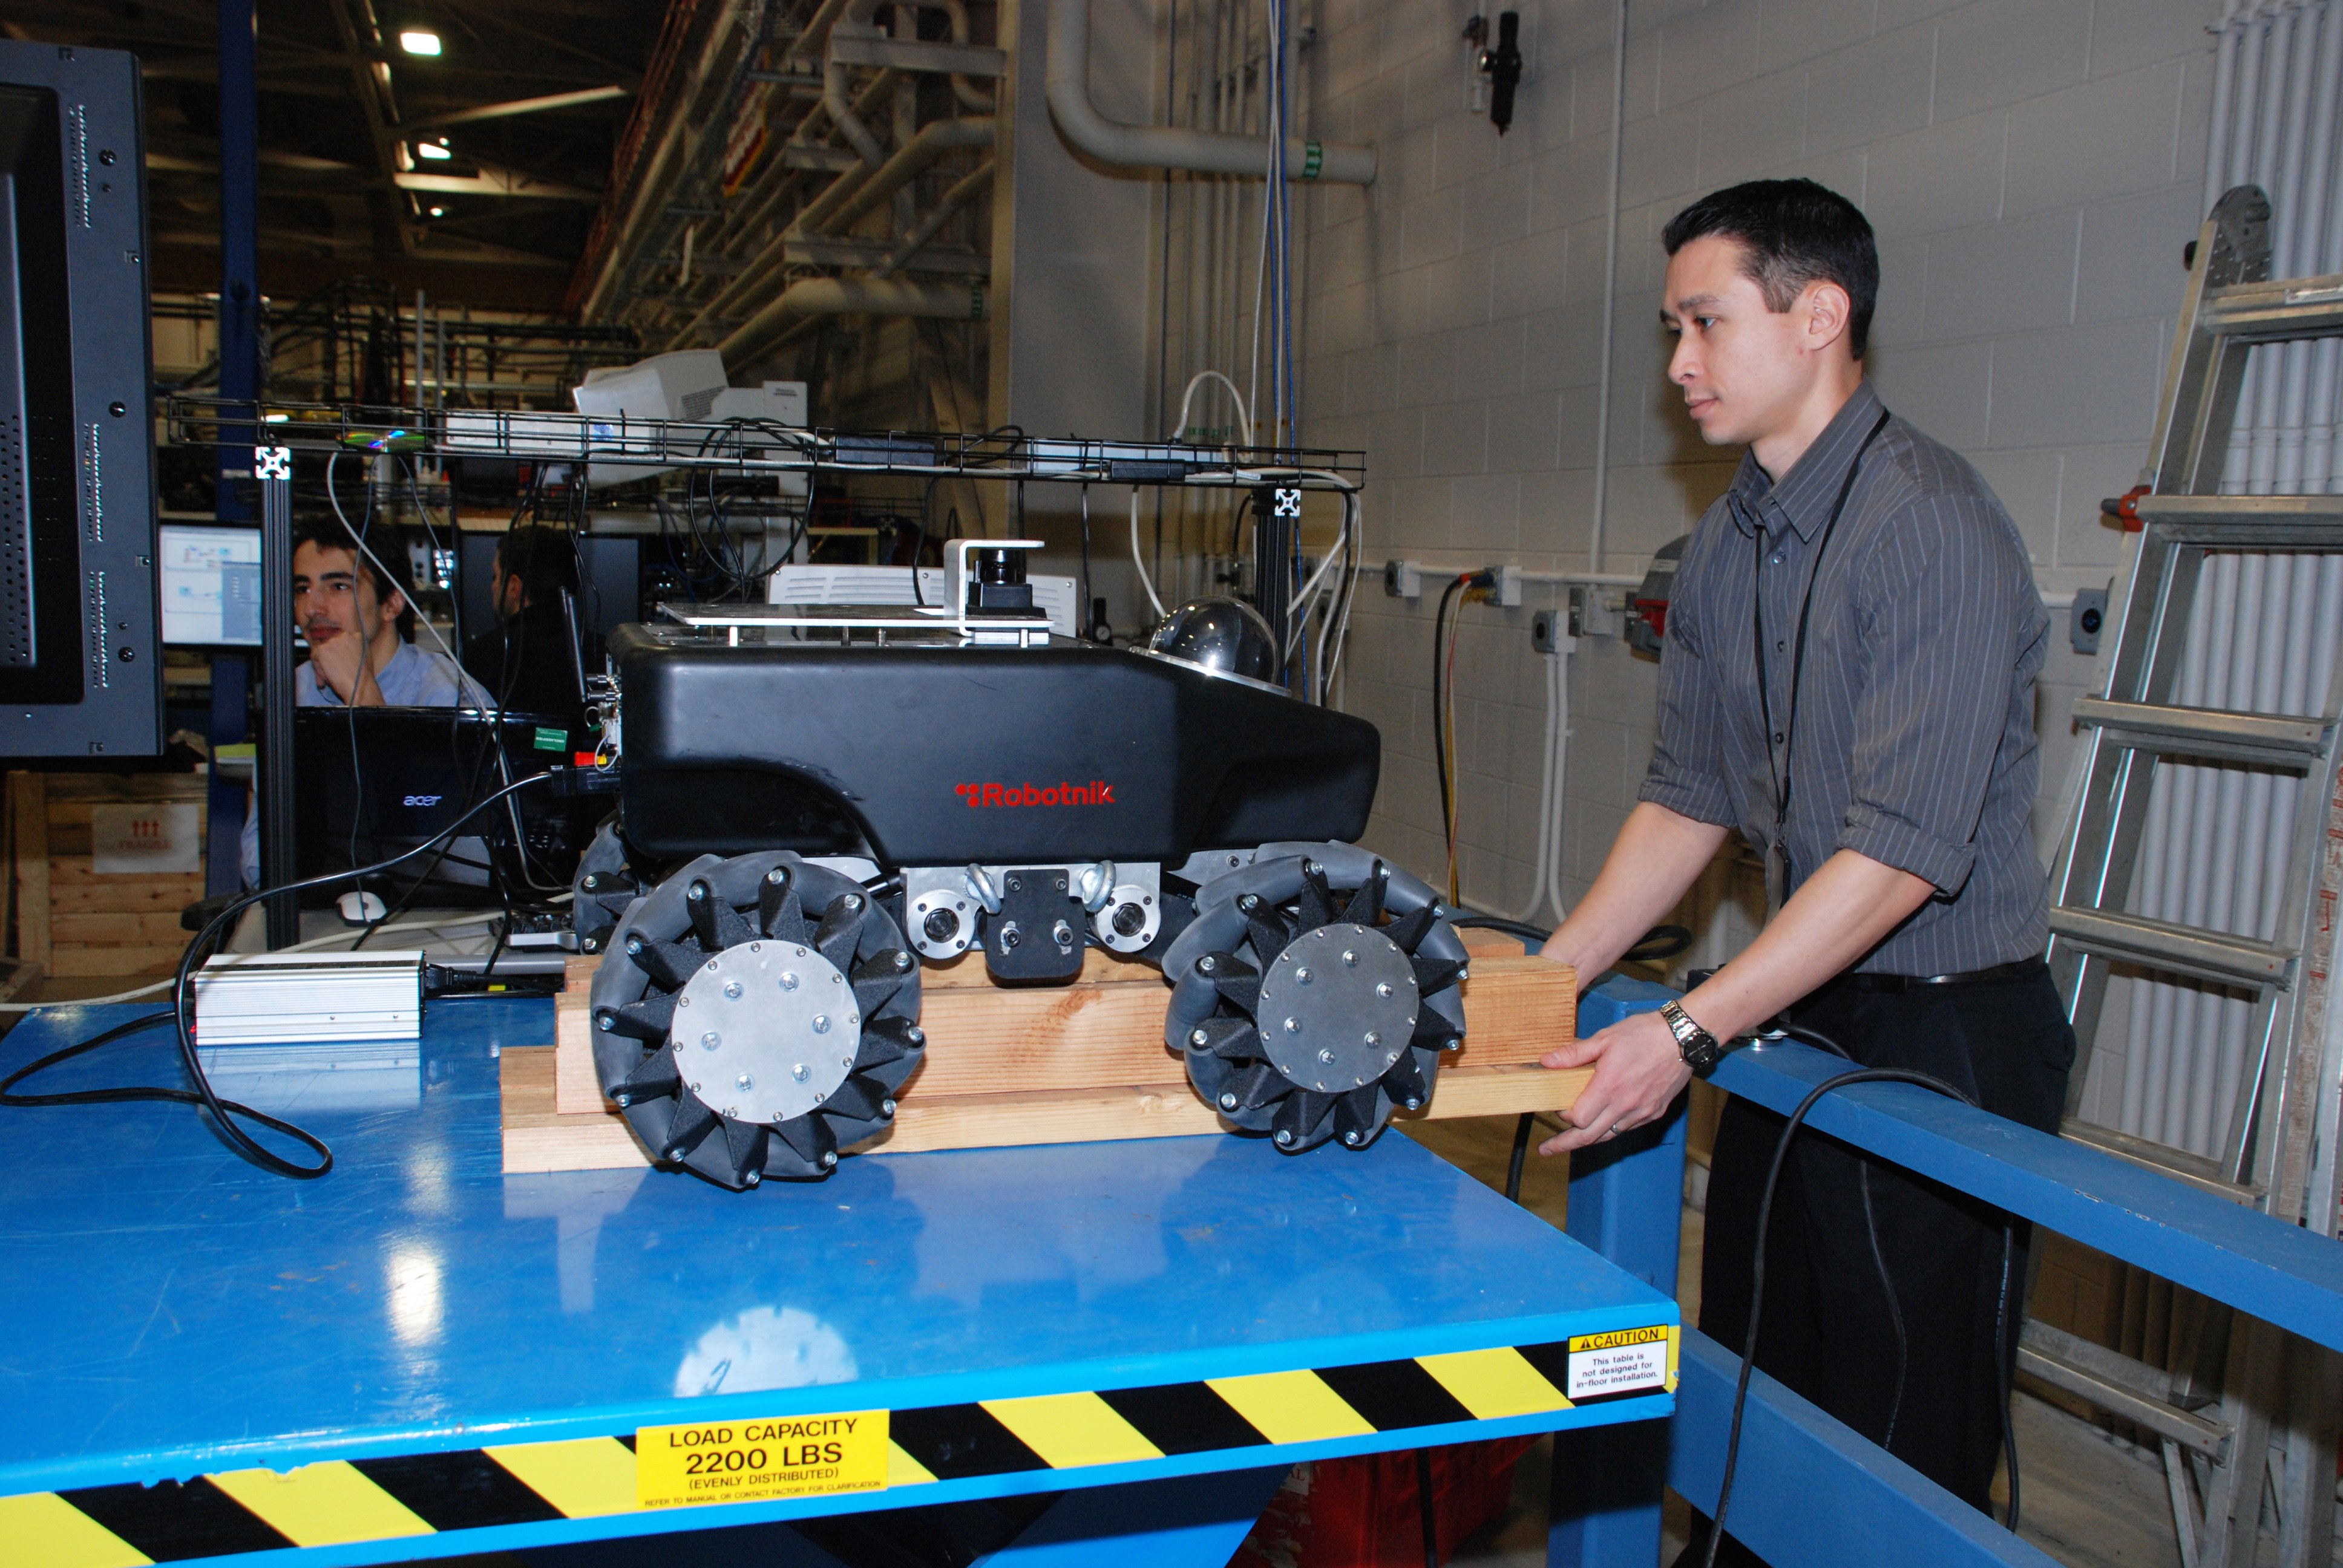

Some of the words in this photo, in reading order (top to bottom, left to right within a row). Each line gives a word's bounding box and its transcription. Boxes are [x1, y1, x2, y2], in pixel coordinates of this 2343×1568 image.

[404, 795, 442, 806] acer
[983, 781, 1116, 808] Robotnik
[1593, 1328, 1659, 1348] CAUTION
[1593, 1357, 1609, 1366] This
[1613, 1354, 1634, 1363] table
[1576, 1377, 1608, 1388] in-floor
[1611, 1371, 1658, 1383] installation.
[1582, 1369, 1596, 1377] not
[1599, 1364, 1637, 1376] designed
[670, 1428, 733, 1448] LOAD
[745, 1418, 857, 1442] CAPACITY
[686, 1448, 767, 1475] 2200
[783, 1442, 842, 1467] LBS
[689, 1475, 743, 1491] (EVENLY
[749, 1467, 839, 1485] DISTRIBUTED)
[735, 1490, 768, 1498] CONTACT
[827, 1481, 881, 1491] CLARIFICATION
